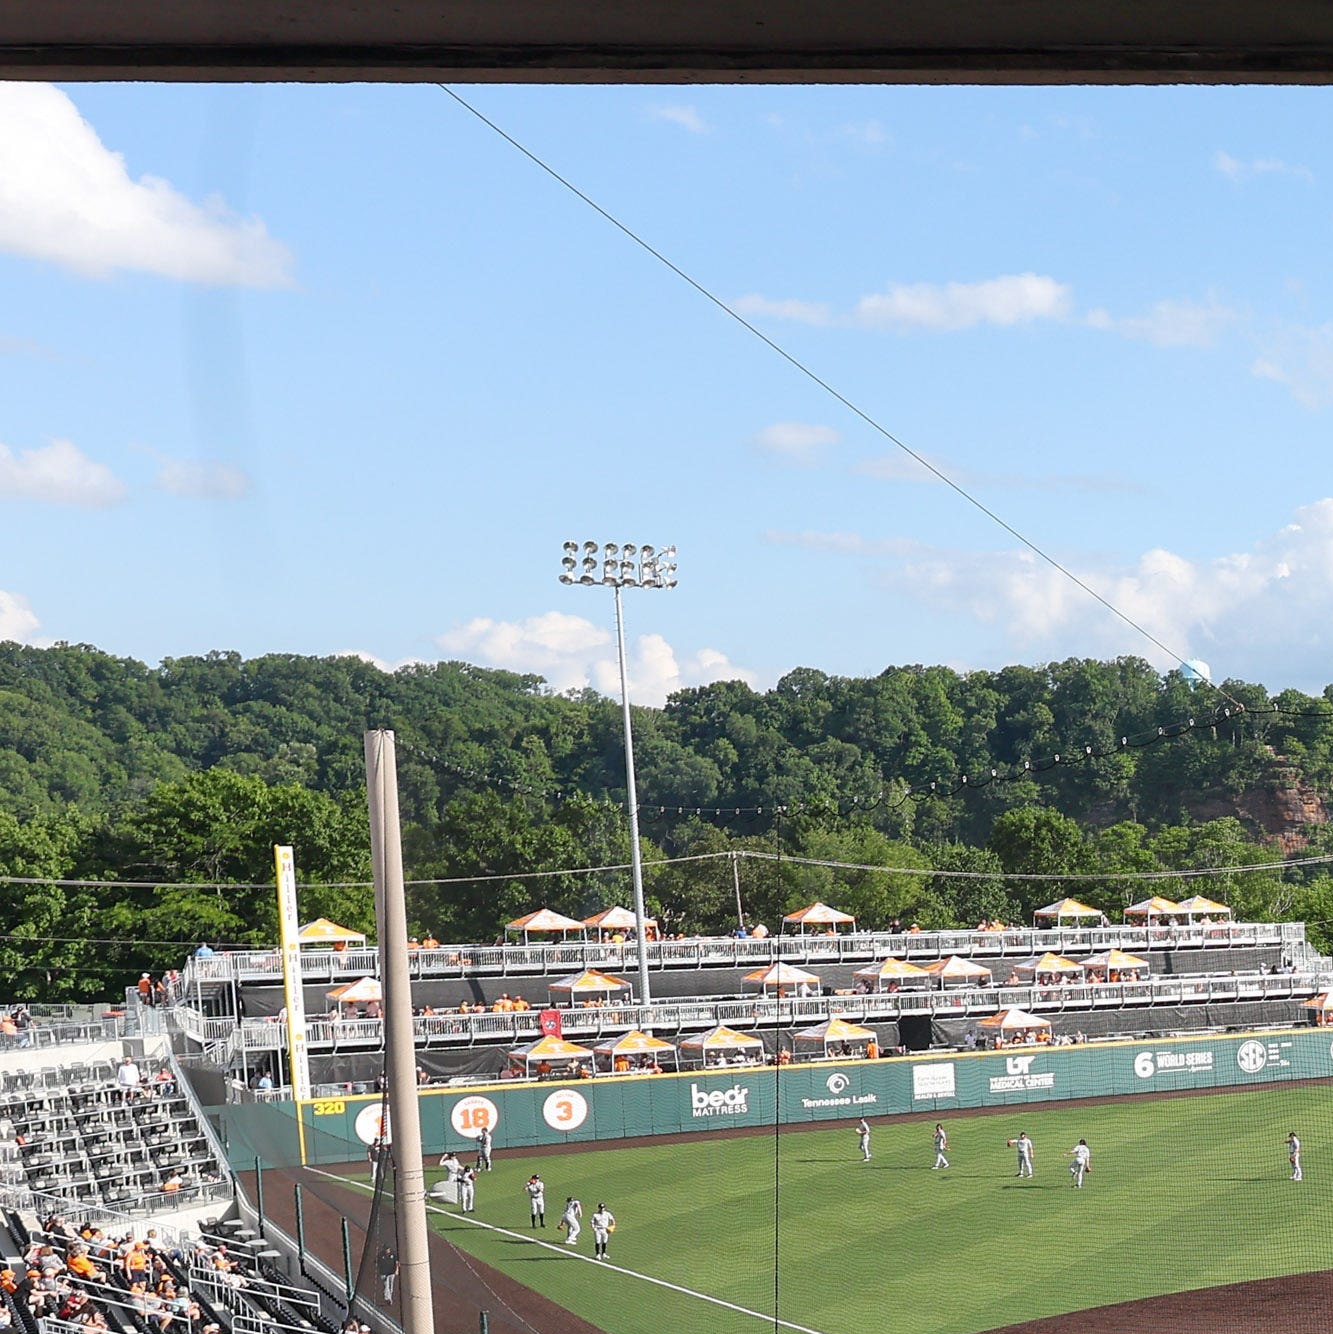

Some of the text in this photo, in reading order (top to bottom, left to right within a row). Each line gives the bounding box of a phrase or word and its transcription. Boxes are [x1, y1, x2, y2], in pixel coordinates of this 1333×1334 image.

[1006, 1055, 1036, 1075] UT
[1134, 1051, 1213, 1078] 6 WORLD SERIES
[990, 1078, 1055, 1090] MEDICAL CENTER
[313, 1101, 346, 1116] 320
[801, 1093, 877, 1108] Tennessee Lasik
[460, 1107, 490, 1130] 18
[556, 1101, 573, 1121] 3
[692, 1103, 748, 1118] MATTRESS
